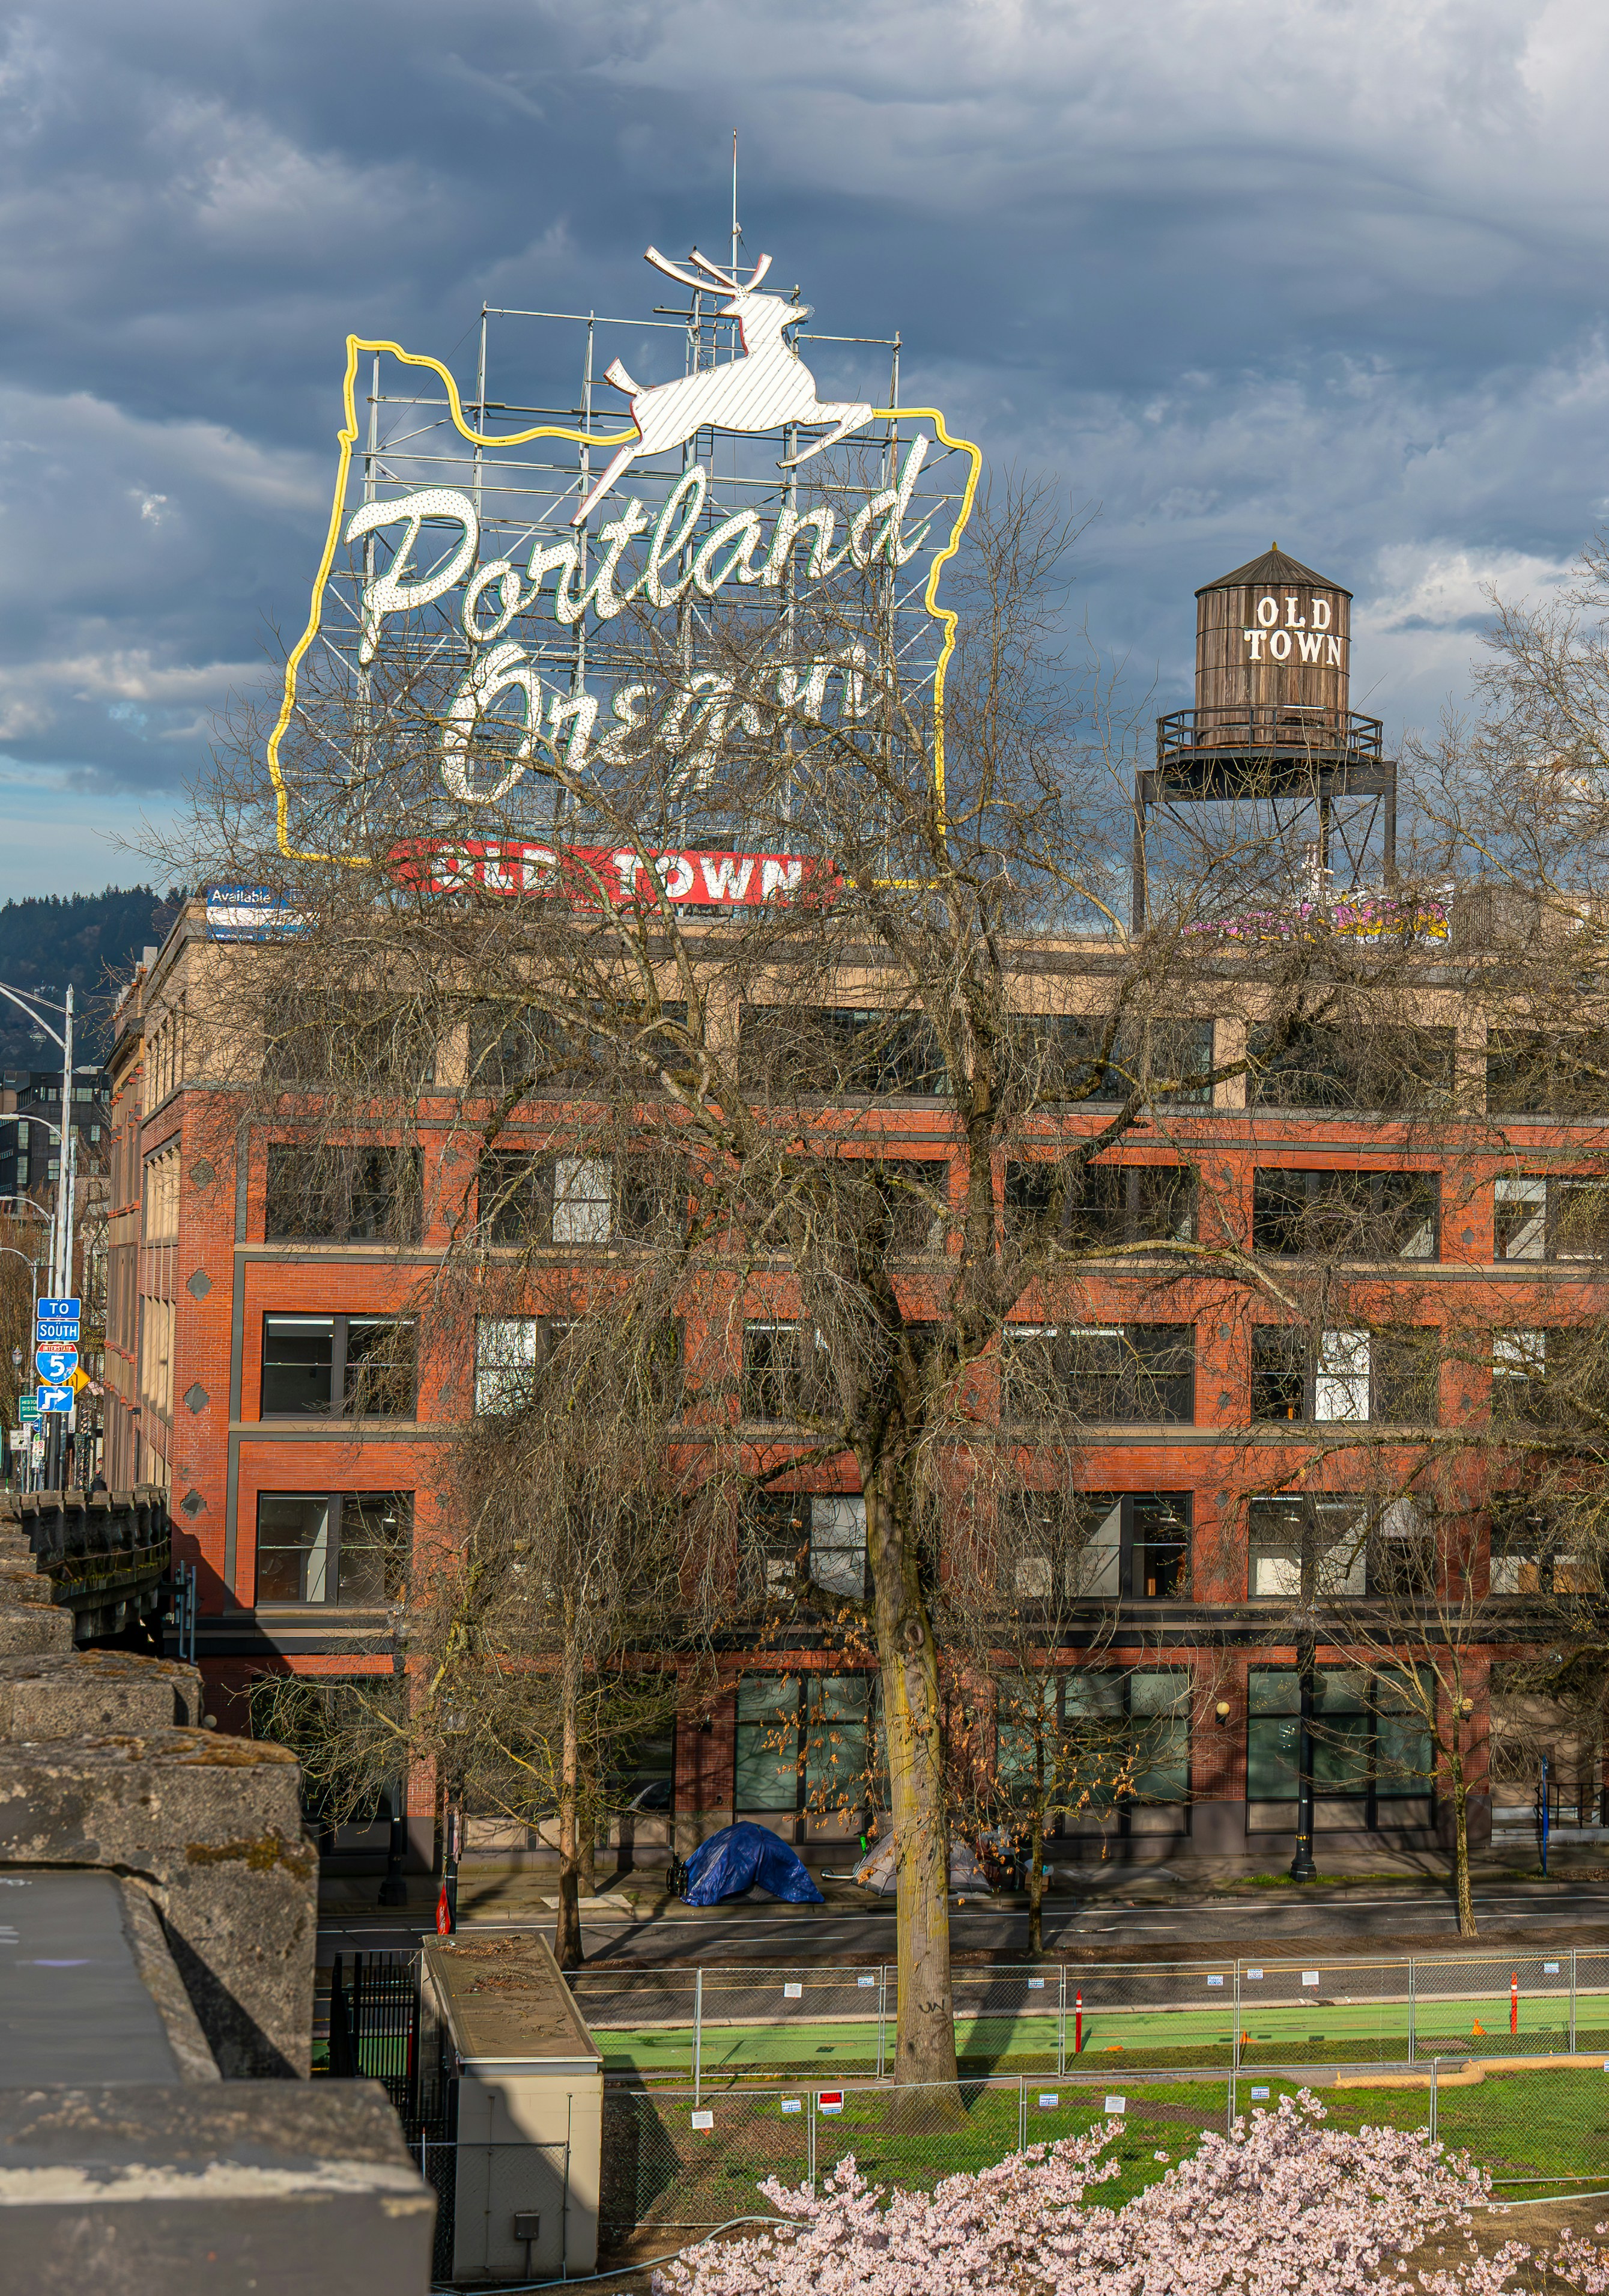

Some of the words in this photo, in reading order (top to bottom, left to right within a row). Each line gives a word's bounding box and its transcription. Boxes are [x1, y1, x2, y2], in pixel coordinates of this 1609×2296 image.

[344, 431, 932, 665] Portland
[1257, 596, 1332, 630] OLD
[1244, 630, 1343, 667] TOWN
[440, 642, 885, 804] Oregon
[429, 845, 561, 891] OLD
[613, 852, 802, 904] TOWN
[211, 889, 271, 904] Available
[49, 1302, 69, 1314] TO
[40, 1324, 77, 1337] SOUTH
[49, 1355, 65, 1377] 5
